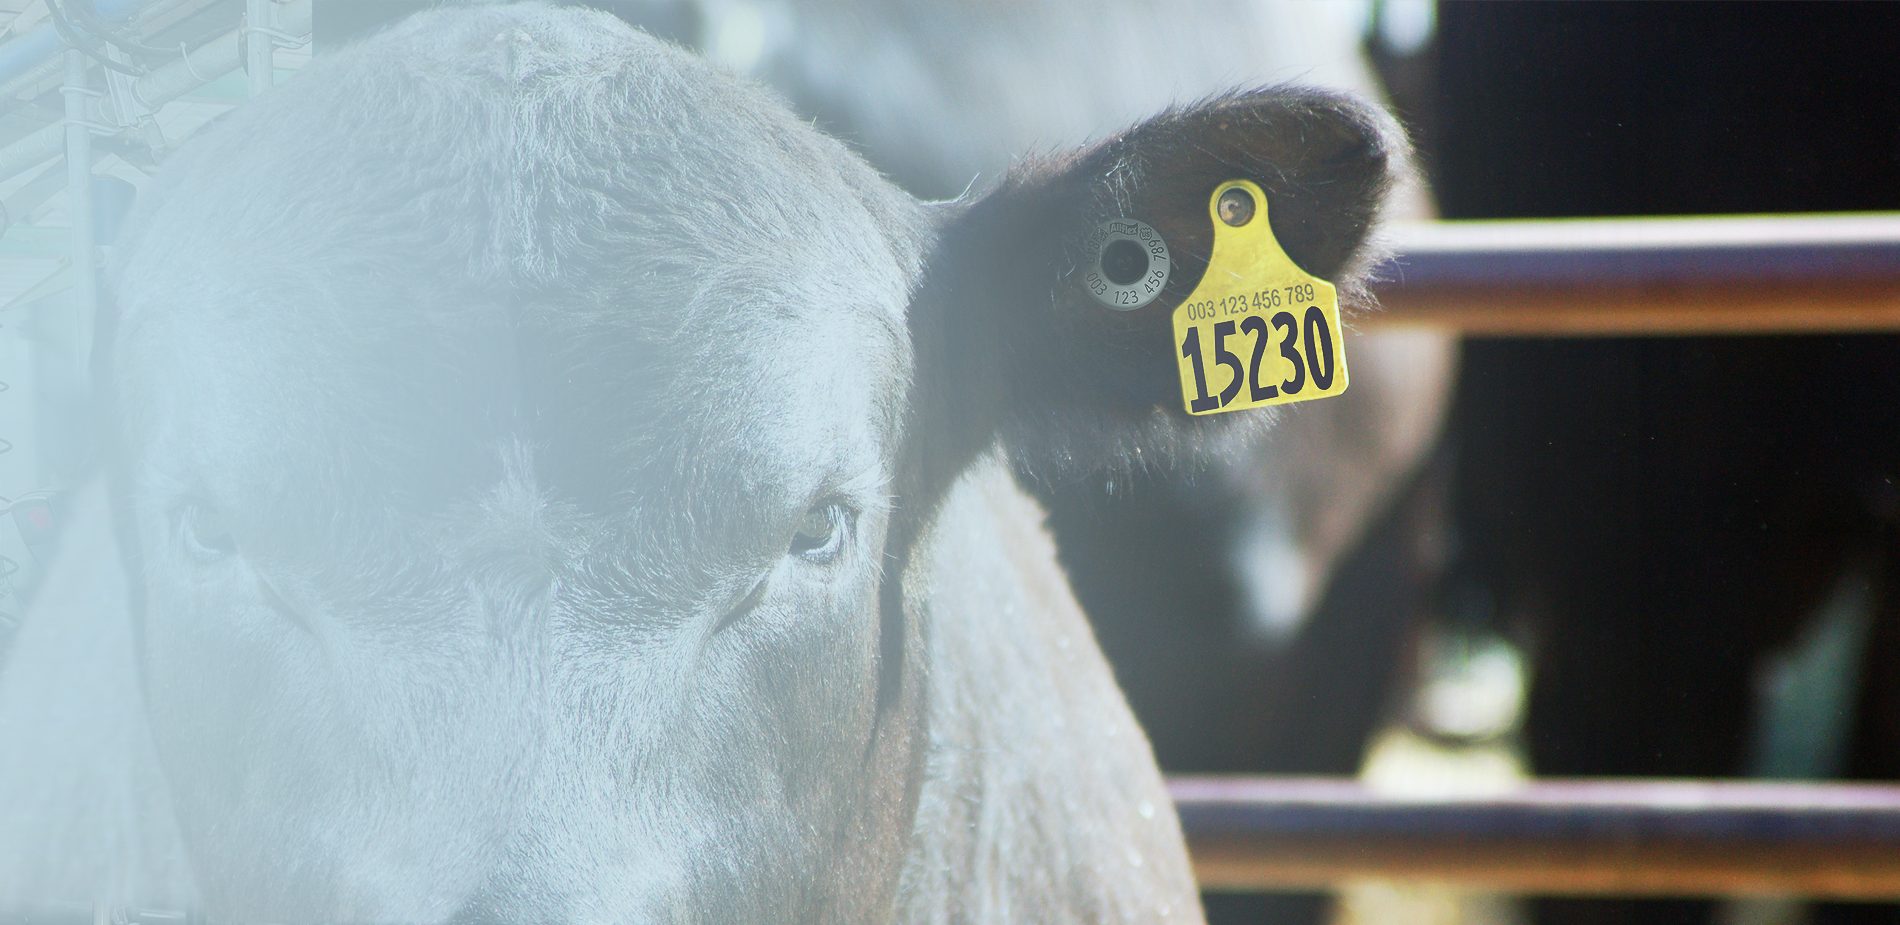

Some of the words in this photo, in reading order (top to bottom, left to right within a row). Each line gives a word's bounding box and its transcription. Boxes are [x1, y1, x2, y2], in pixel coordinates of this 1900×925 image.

[1149, 240, 1167, 261] 789
[1087, 273, 1107, 295] 003
[1144, 270, 1164, 294] 456
[1114, 290, 1139, 305] 123
[1187, 300, 1216, 321] 003
[1220, 294, 1248, 316] 123
[1252, 289, 1281, 310] 456
[1284, 283, 1315, 305] 789
[1181, 305, 1335, 414] 15230
